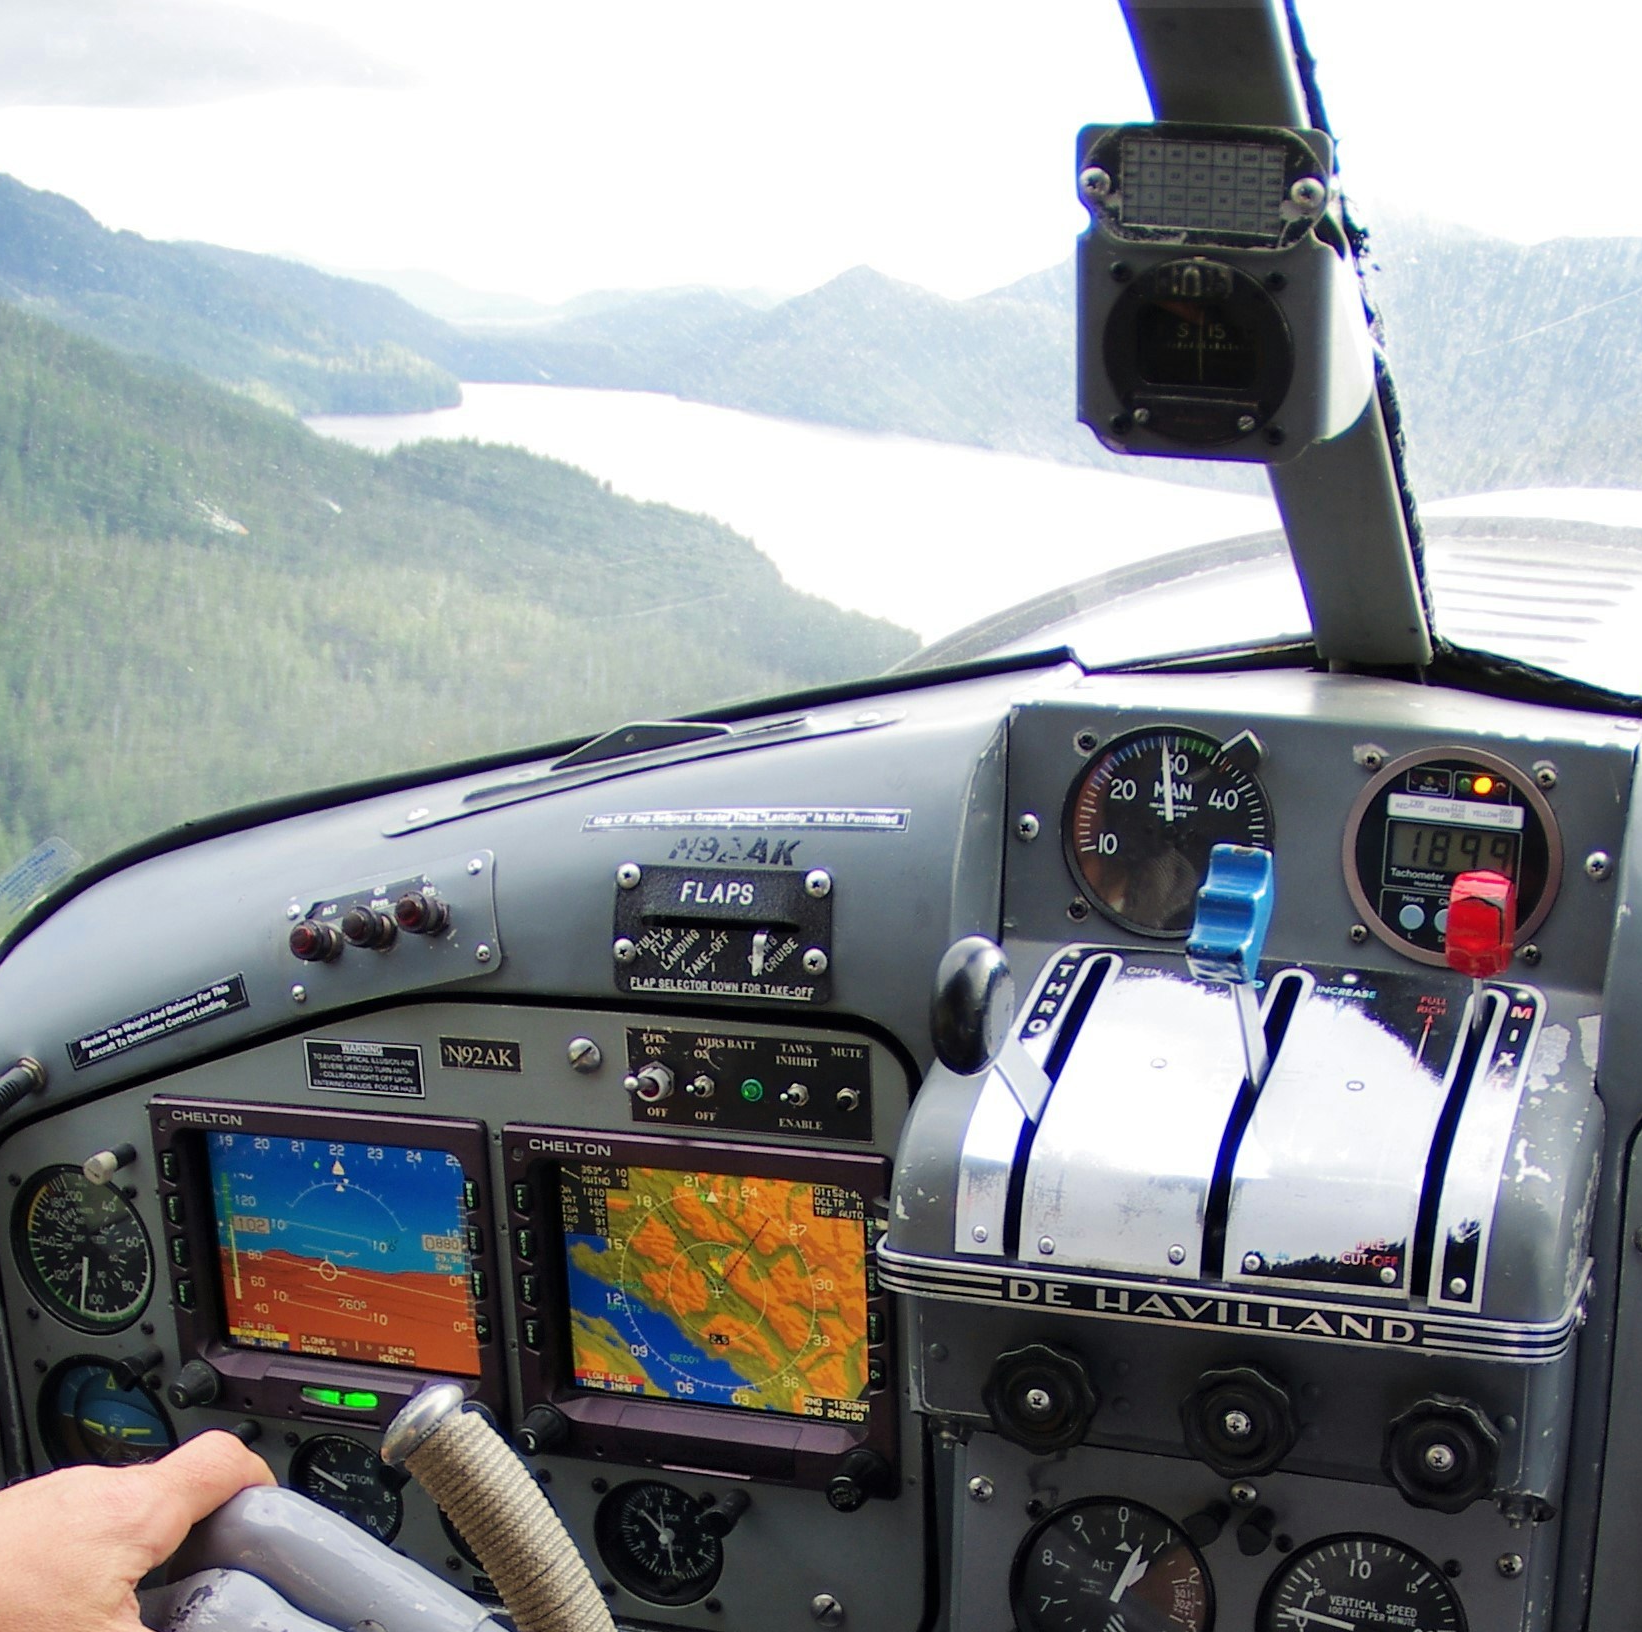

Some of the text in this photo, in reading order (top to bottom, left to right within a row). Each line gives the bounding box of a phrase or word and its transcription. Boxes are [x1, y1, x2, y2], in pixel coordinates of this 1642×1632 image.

[1111, 779, 1136, 801] 20
[1208, 788, 1238, 811] 40
[630, 814, 650, 824] Flap
[761, 812, 898, 824] "Landing" Not Permitted
[1098, 834, 1118, 854] 10
[1413, 831, 1510, 870] 1899
[1391, 868, 1445, 881] Tachometer
[680, 881, 754, 905] FLAPS
[1402, 894, 1425, 904] Hours
[322, 905, 337, 916] ALT
[635, 929, 660, 955] FULL
[650, 928, 674, 956] FLAP
[661, 929, 700, 971] LANDING
[685, 931, 730, 978] TAKE-OFF
[764, 937, 799, 973] CRUISE
[1127, 966, 1161, 976] OPEN
[630, 977, 814, 998] FLAP SELECTOR DOWN FOR TAKE-OFF
[1316, 986, 1376, 999] INCREASE
[1421, 996, 1446, 1005] FULL
[80, 984, 230, 1050] Review The Weight And Balance For This
[89, 1011, 195, 1059] Aircraft Determine Correct
[341, 1044, 383, 1055] WARNING
[728, 1040, 756, 1050] BATT
[780, 1043, 813, 1054] TAWS
[446, 1044, 514, 1066] N92AK
[831, 1047, 863, 1059] MUTE
[776, 1056, 819, 1067] INHIBIT
[172, 1111, 242, 1126] CHELTON
[647, 1107, 668, 1118] OFF
[695, 1110, 716, 1120] OFF
[779, 1118, 823, 1131] ENABLE
[220, 1135, 422, 1163] 19 20 21 22 23 24
[529, 1139, 611, 1156] CHELTON
[684, 1175, 699, 1187] 21
[741, 1186, 757, 1198] 24
[102, 1201, 116, 1212] 40
[636, 1196, 652, 1208] 18
[238, 1219, 267, 1231] 102
[789, 1224, 806, 1236] 27
[126, 1237, 140, 1247] 60
[608, 1238, 624, 1250] 15
[1342, 1252, 1398, 1267] CUT-OFF
[121, 1280, 134, 1292] 80
[815, 1279, 833, 1292] 30
[606, 1293, 623, 1305] 12
[1010, 1281, 1418, 1343] DE HAVILLAND
[813, 1335, 830, 1347] 33
[631, 1345, 648, 1358] 09
[609, 1372, 632, 1383] FUEL
[782, 1376, 799, 1389] 36
[677, 1382, 695, 1394] 06
[332, 1472, 374, 1485] SUCTION
[1092, 1560, 1114, 1572] ALT
[1350, 1561, 1372, 1579] 10
[1407, 1581, 1418, 1593] 15
[1330, 1595, 1417, 1618] VERTICAL SPEED
[1329, 1606, 1416, 1626] 100 FEET PER MINUTE
